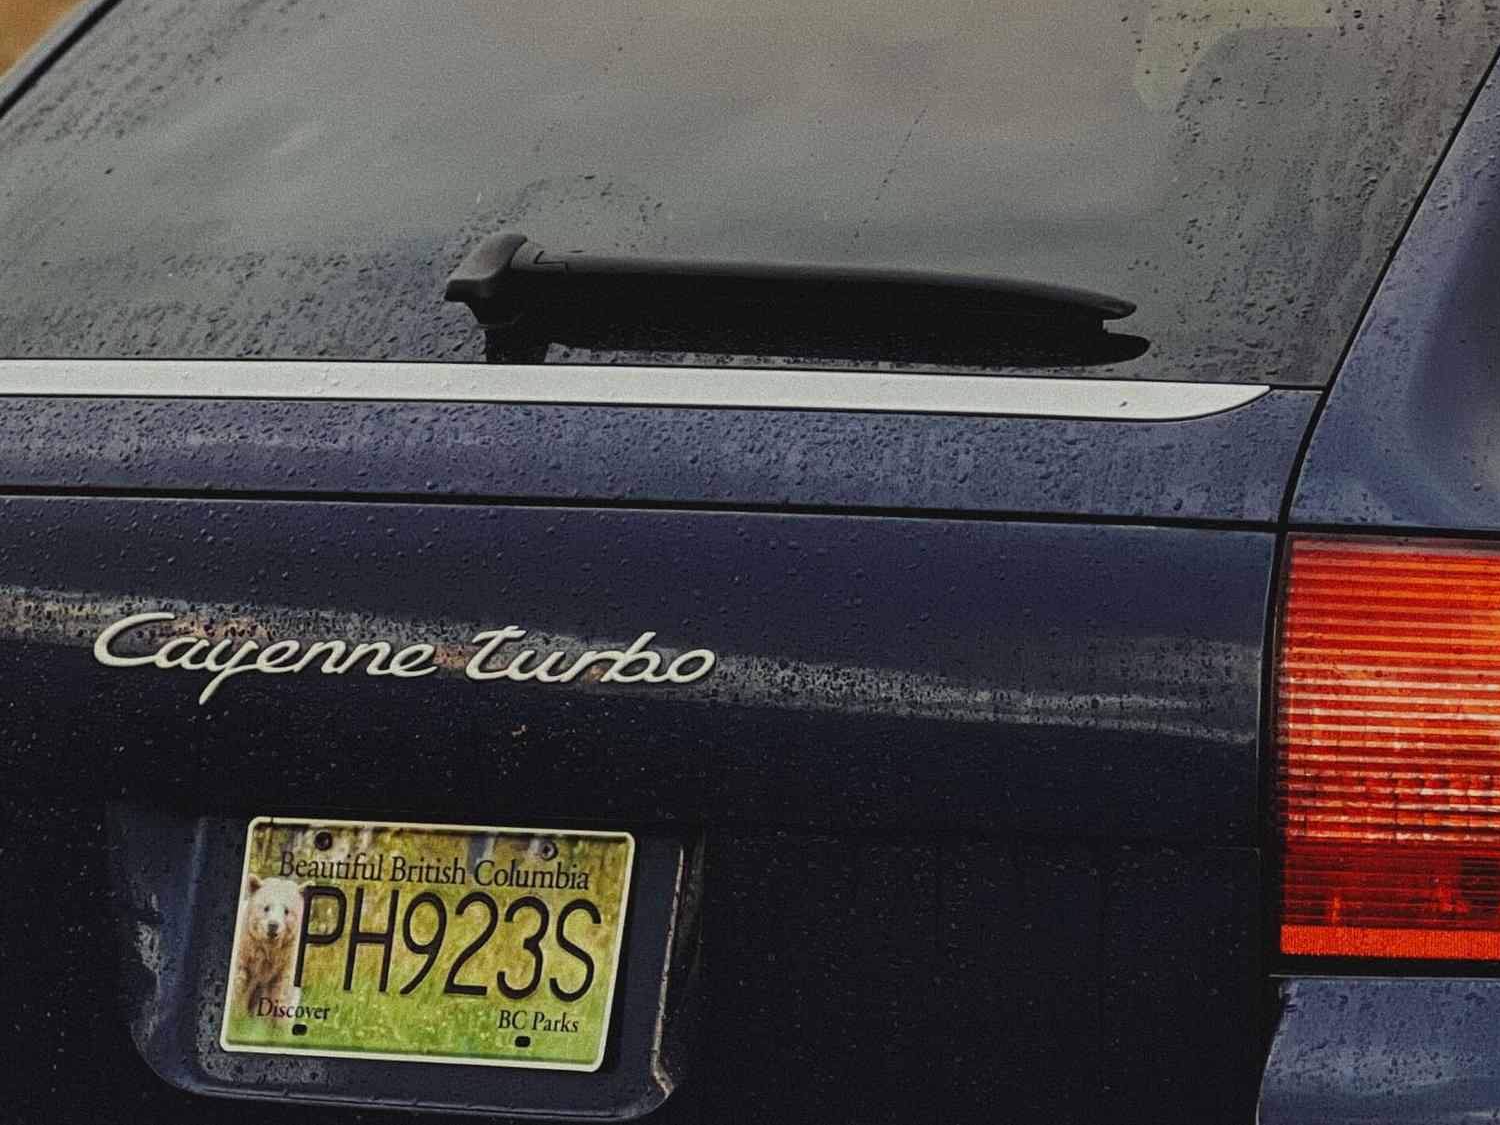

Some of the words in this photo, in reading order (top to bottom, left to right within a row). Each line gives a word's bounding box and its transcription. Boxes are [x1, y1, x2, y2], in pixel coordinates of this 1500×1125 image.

[93, 612, 440, 705] Cayenne
[466, 626, 715, 683] turbo
[278, 850, 384, 882] Beautiful
[388, 856, 467, 886] British
[473, 859, 590, 891] Columbia
[293, 886, 602, 1002] PH923S
[257, 998, 331, 1022] Discover
[498, 1010, 528, 1031] BC
[532, 1012, 580, 1034] Parks
